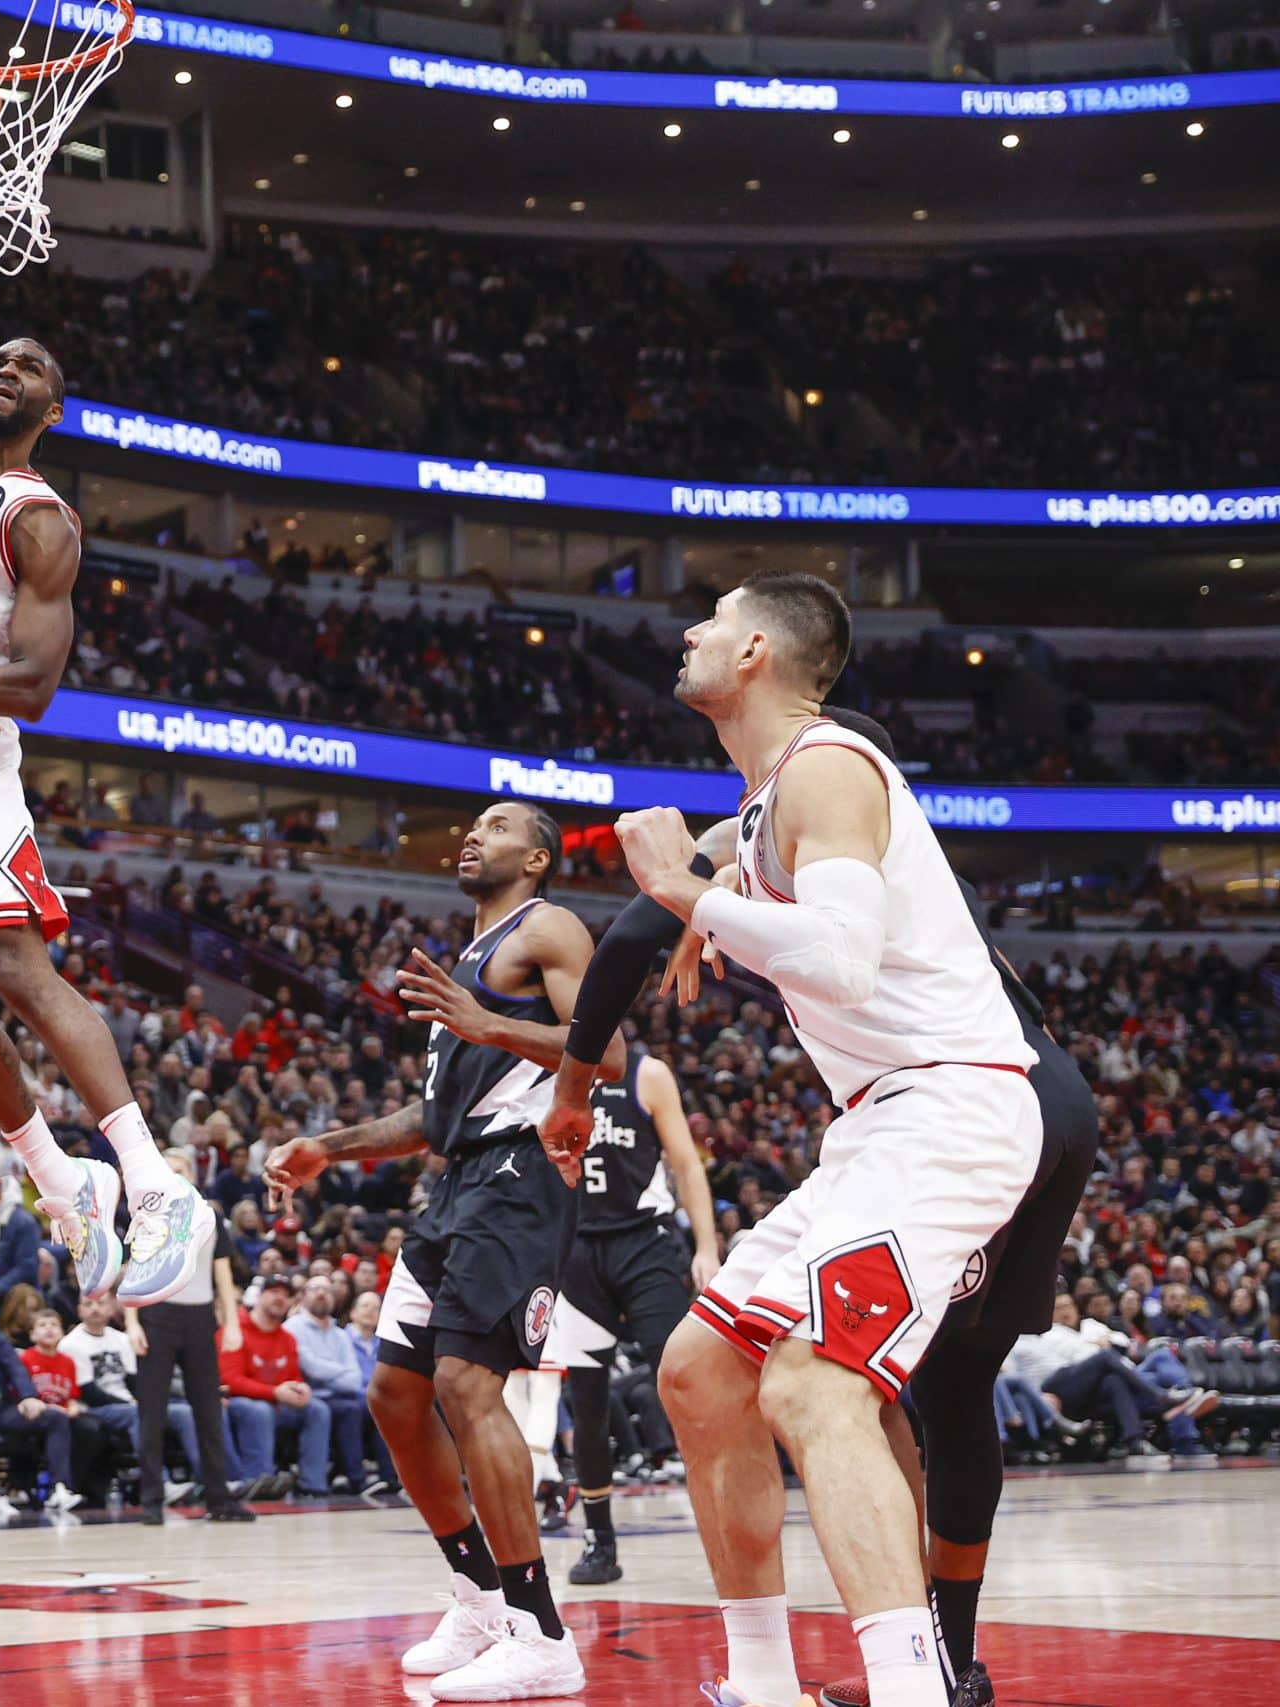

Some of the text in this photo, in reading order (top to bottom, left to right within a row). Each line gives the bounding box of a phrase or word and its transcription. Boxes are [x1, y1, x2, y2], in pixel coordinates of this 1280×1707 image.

[165, 20, 275, 59] TRADING
[389, 56, 587, 99] us.plus500.com
[715, 79, 838, 110] Plus500
[961, 82, 1190, 115] FUTURES TRADING
[82, 409, 282, 472] us.plus500.com
[418, 461, 546, 500] Plus500
[672, 486, 910, 520] FUTURES TRADING
[1047, 494, 1280, 528] us.plus500.com
[118, 710, 357, 768] us.plus500.com
[490, 757, 614, 805] Plus500
[1172, 794, 1280, 833] us.plu
[584, 1157, 608, 1194] 5
